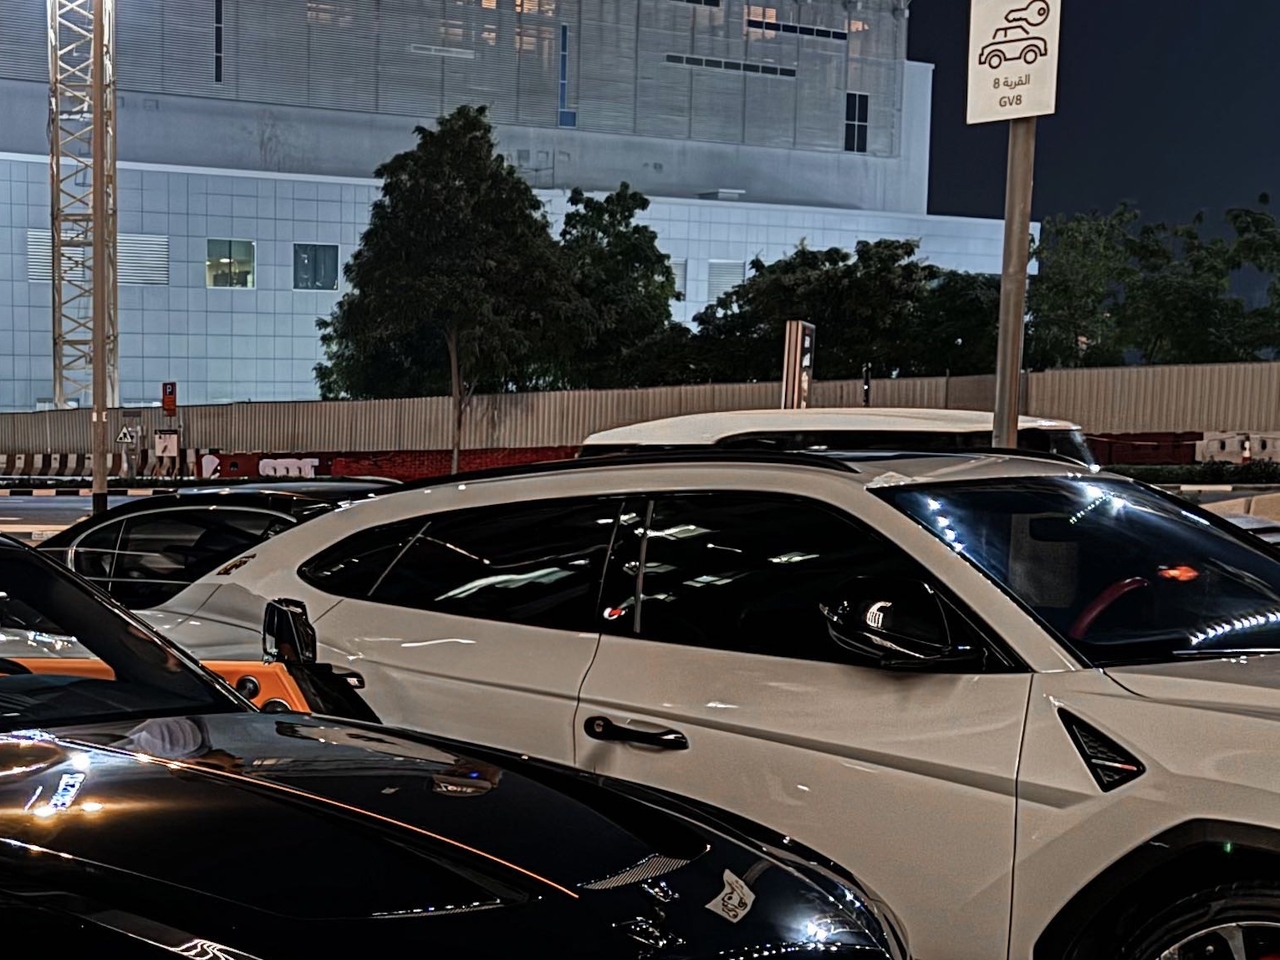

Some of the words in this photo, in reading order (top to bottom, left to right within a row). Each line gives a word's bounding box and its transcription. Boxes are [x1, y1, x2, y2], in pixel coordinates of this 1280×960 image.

[993, 78, 1000, 89] 8
[1002, 74, 1031, 89] القرية
[999, 94, 1022, 107] GV8
[166, 385, 172, 395] P
